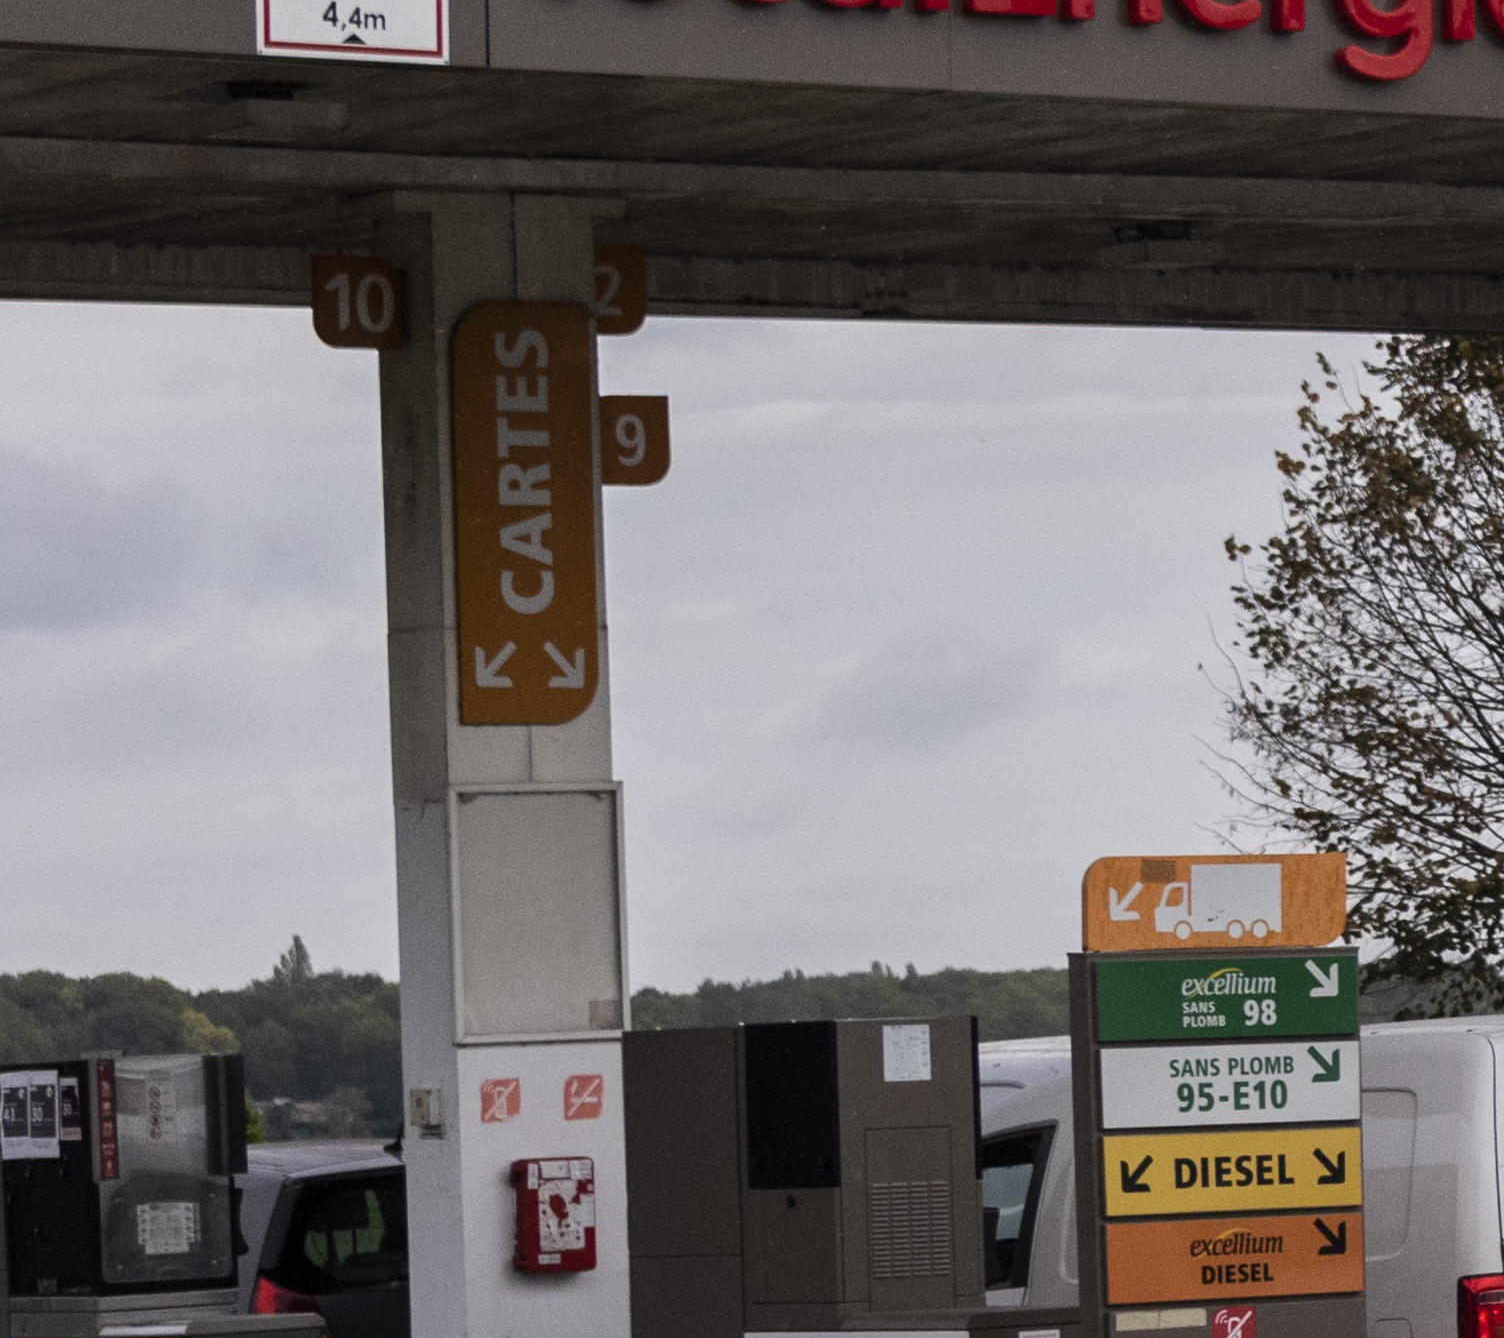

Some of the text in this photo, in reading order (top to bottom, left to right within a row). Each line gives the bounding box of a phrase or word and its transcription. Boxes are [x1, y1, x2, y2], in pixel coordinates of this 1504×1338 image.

[322, 1, 387, 32] 4,4m
[324, 273, 395, 334] 10
[615, 414, 646, 467] 9
[495, 329, 555, 615] CARTES
[1181, 972, 1277, 996] excellium
[1182, 1001, 1216, 1014] SANS
[1183, 1015, 1226, 1027] PLOMB
[1244, 999, 1277, 1026] 98
[1169, 1056, 1294, 1078] SANS PLOMB
[1177, 1079, 1288, 1113] 95-E10
[1174, 1154, 1295, 1189] DIESEL
[1190, 1231, 1284, 1258] excellium
[1201, 1263, 1274, 1285] DIESEL
